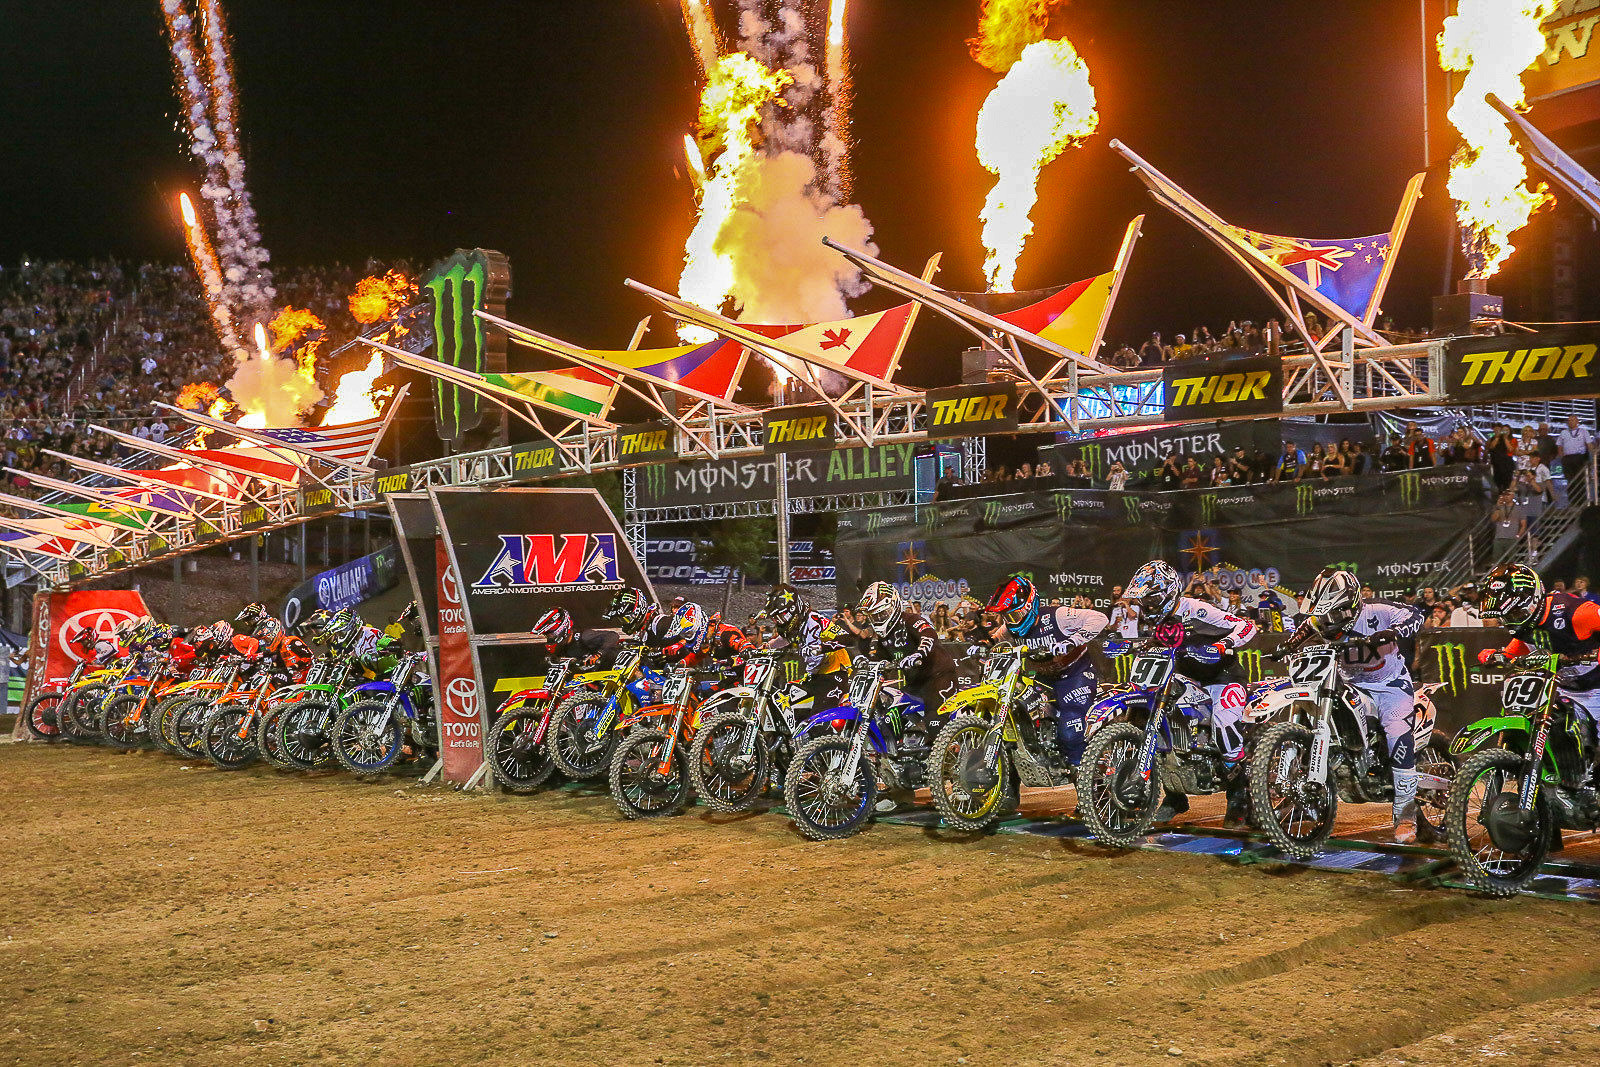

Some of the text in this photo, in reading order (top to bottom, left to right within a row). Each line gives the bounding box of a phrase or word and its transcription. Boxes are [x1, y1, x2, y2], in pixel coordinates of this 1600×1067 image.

[1461, 344, 1598, 386] THOR
[1171, 371, 1271, 407] THOR
[932, 395, 1008, 426] THOR
[768, 416, 827, 444] THOR
[621, 428, 667, 455] THOR
[1106, 432, 1226, 466] MONSTER
[514, 448, 555, 471] THOR
[675, 443, 915, 494] MONSTER ALLEY
[377, 473, 408, 494] THOR
[1313, 485, 1355, 497] MONSTER
[1421, 474, 1468, 486] MONSTER
[305, 489, 332, 507] THOR
[1001, 502, 1035, 512] MONSTER
[1072, 500, 1105, 509] MONSTER
[1216, 496, 1255, 505] MONSTER
[242, 507, 265, 525] THOR
[471, 533, 625, 588] AMA
[1378, 559, 1452, 577] MONSTER
[329, 566, 368, 602] YAMAHA
[472, 587, 514, 595] AMERICAN
[576, 583, 626, 592] ASSOCIATION
[902, 580, 967, 599] ELCOME
[1050, 572, 1104, 586] MONSTER
[439, 608, 465, 623] TOYO
[745, 665, 768, 686] 21
[1132, 659, 1171, 686] 91
[1291, 656, 1332, 683] 22
[1503, 677, 1544, 706] 69
[1525, 768, 1538, 811] DUNLOP
